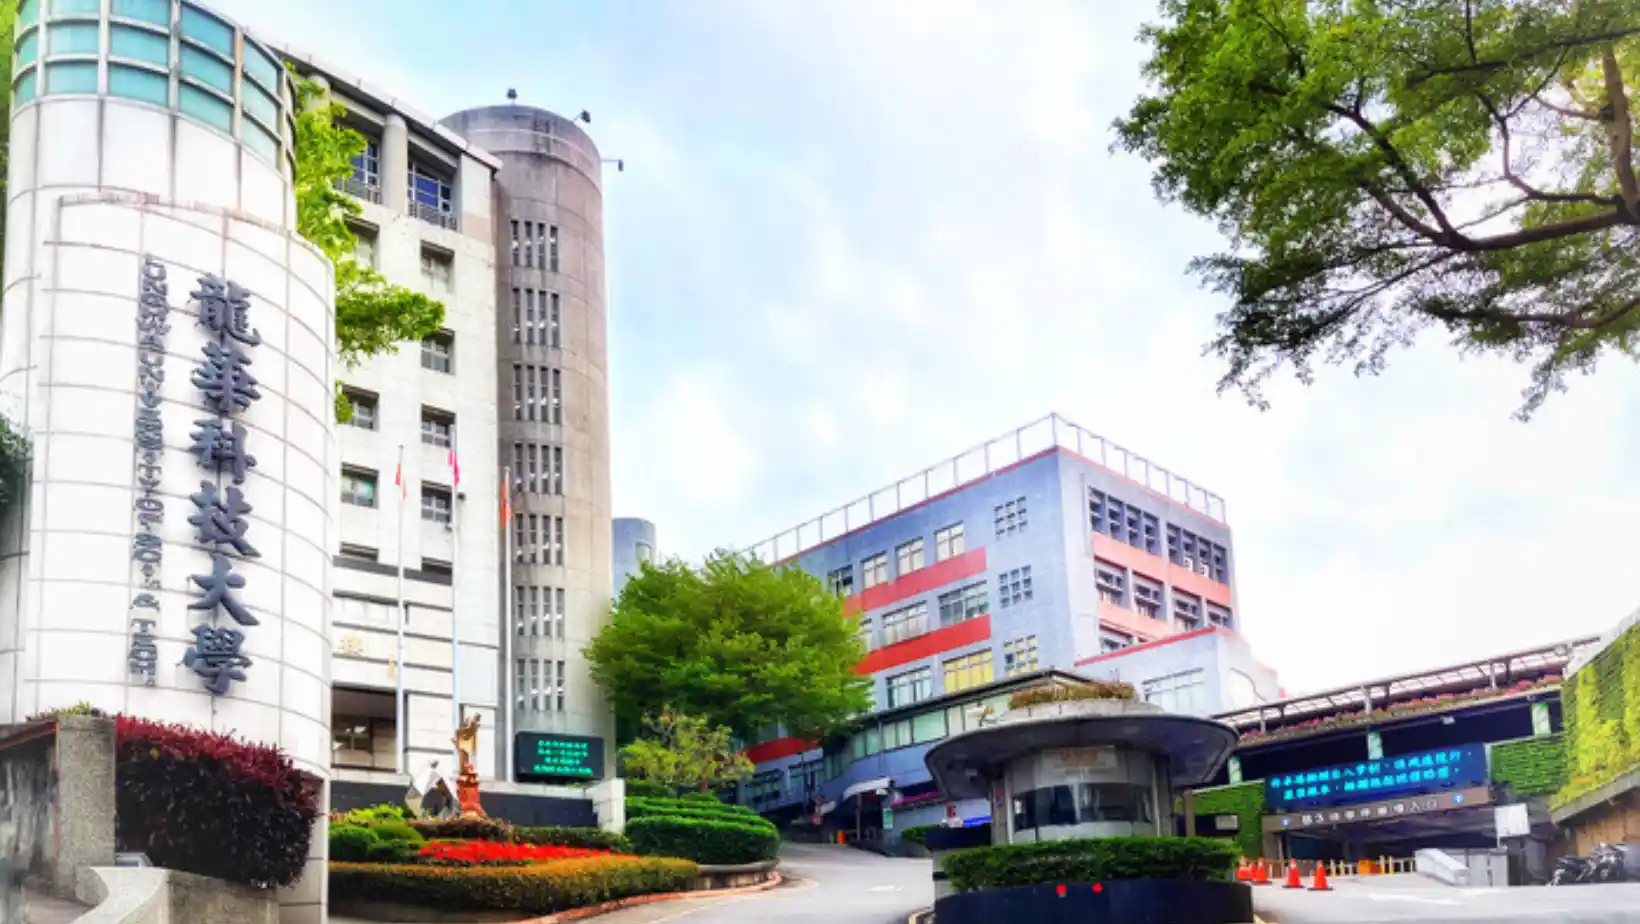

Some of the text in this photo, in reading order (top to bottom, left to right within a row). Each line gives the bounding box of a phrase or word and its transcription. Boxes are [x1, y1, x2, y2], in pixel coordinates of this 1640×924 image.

[181, 273, 260, 696] 龍華科技大學
